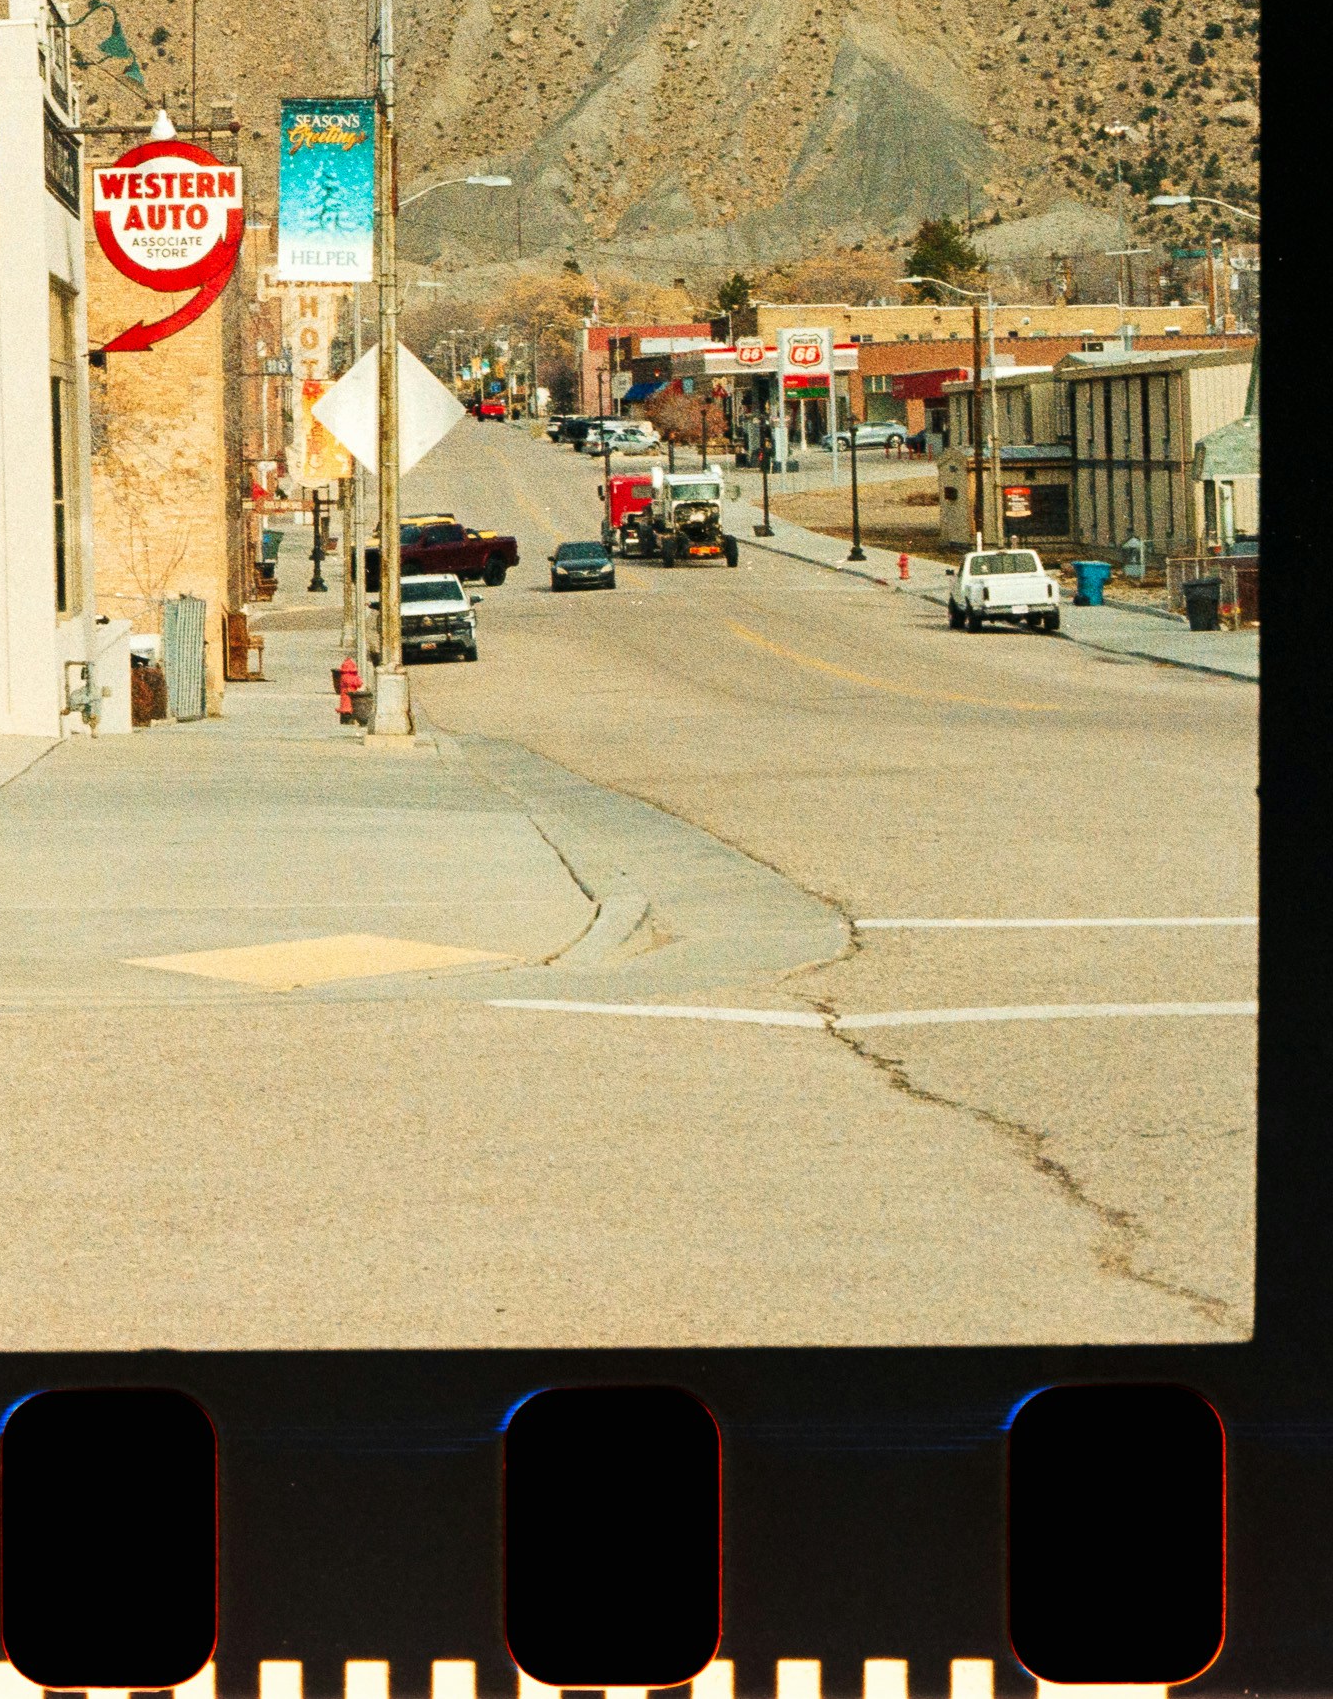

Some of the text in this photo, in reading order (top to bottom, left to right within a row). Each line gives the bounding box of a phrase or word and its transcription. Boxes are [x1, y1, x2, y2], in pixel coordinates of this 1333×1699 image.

[295, 113, 360, 129] SEASON'S
[98, 171, 236, 200] WESTERN
[123, 203, 209, 231] AUTO
[132, 236, 203, 247] ASSOCIATE
[146, 248, 189, 259] STORE
[291, 250, 359, 267] HELPER
[298, 295, 320, 378] HOT
[742, 348, 761, 360] 66
[794, 347, 817, 362] 66
